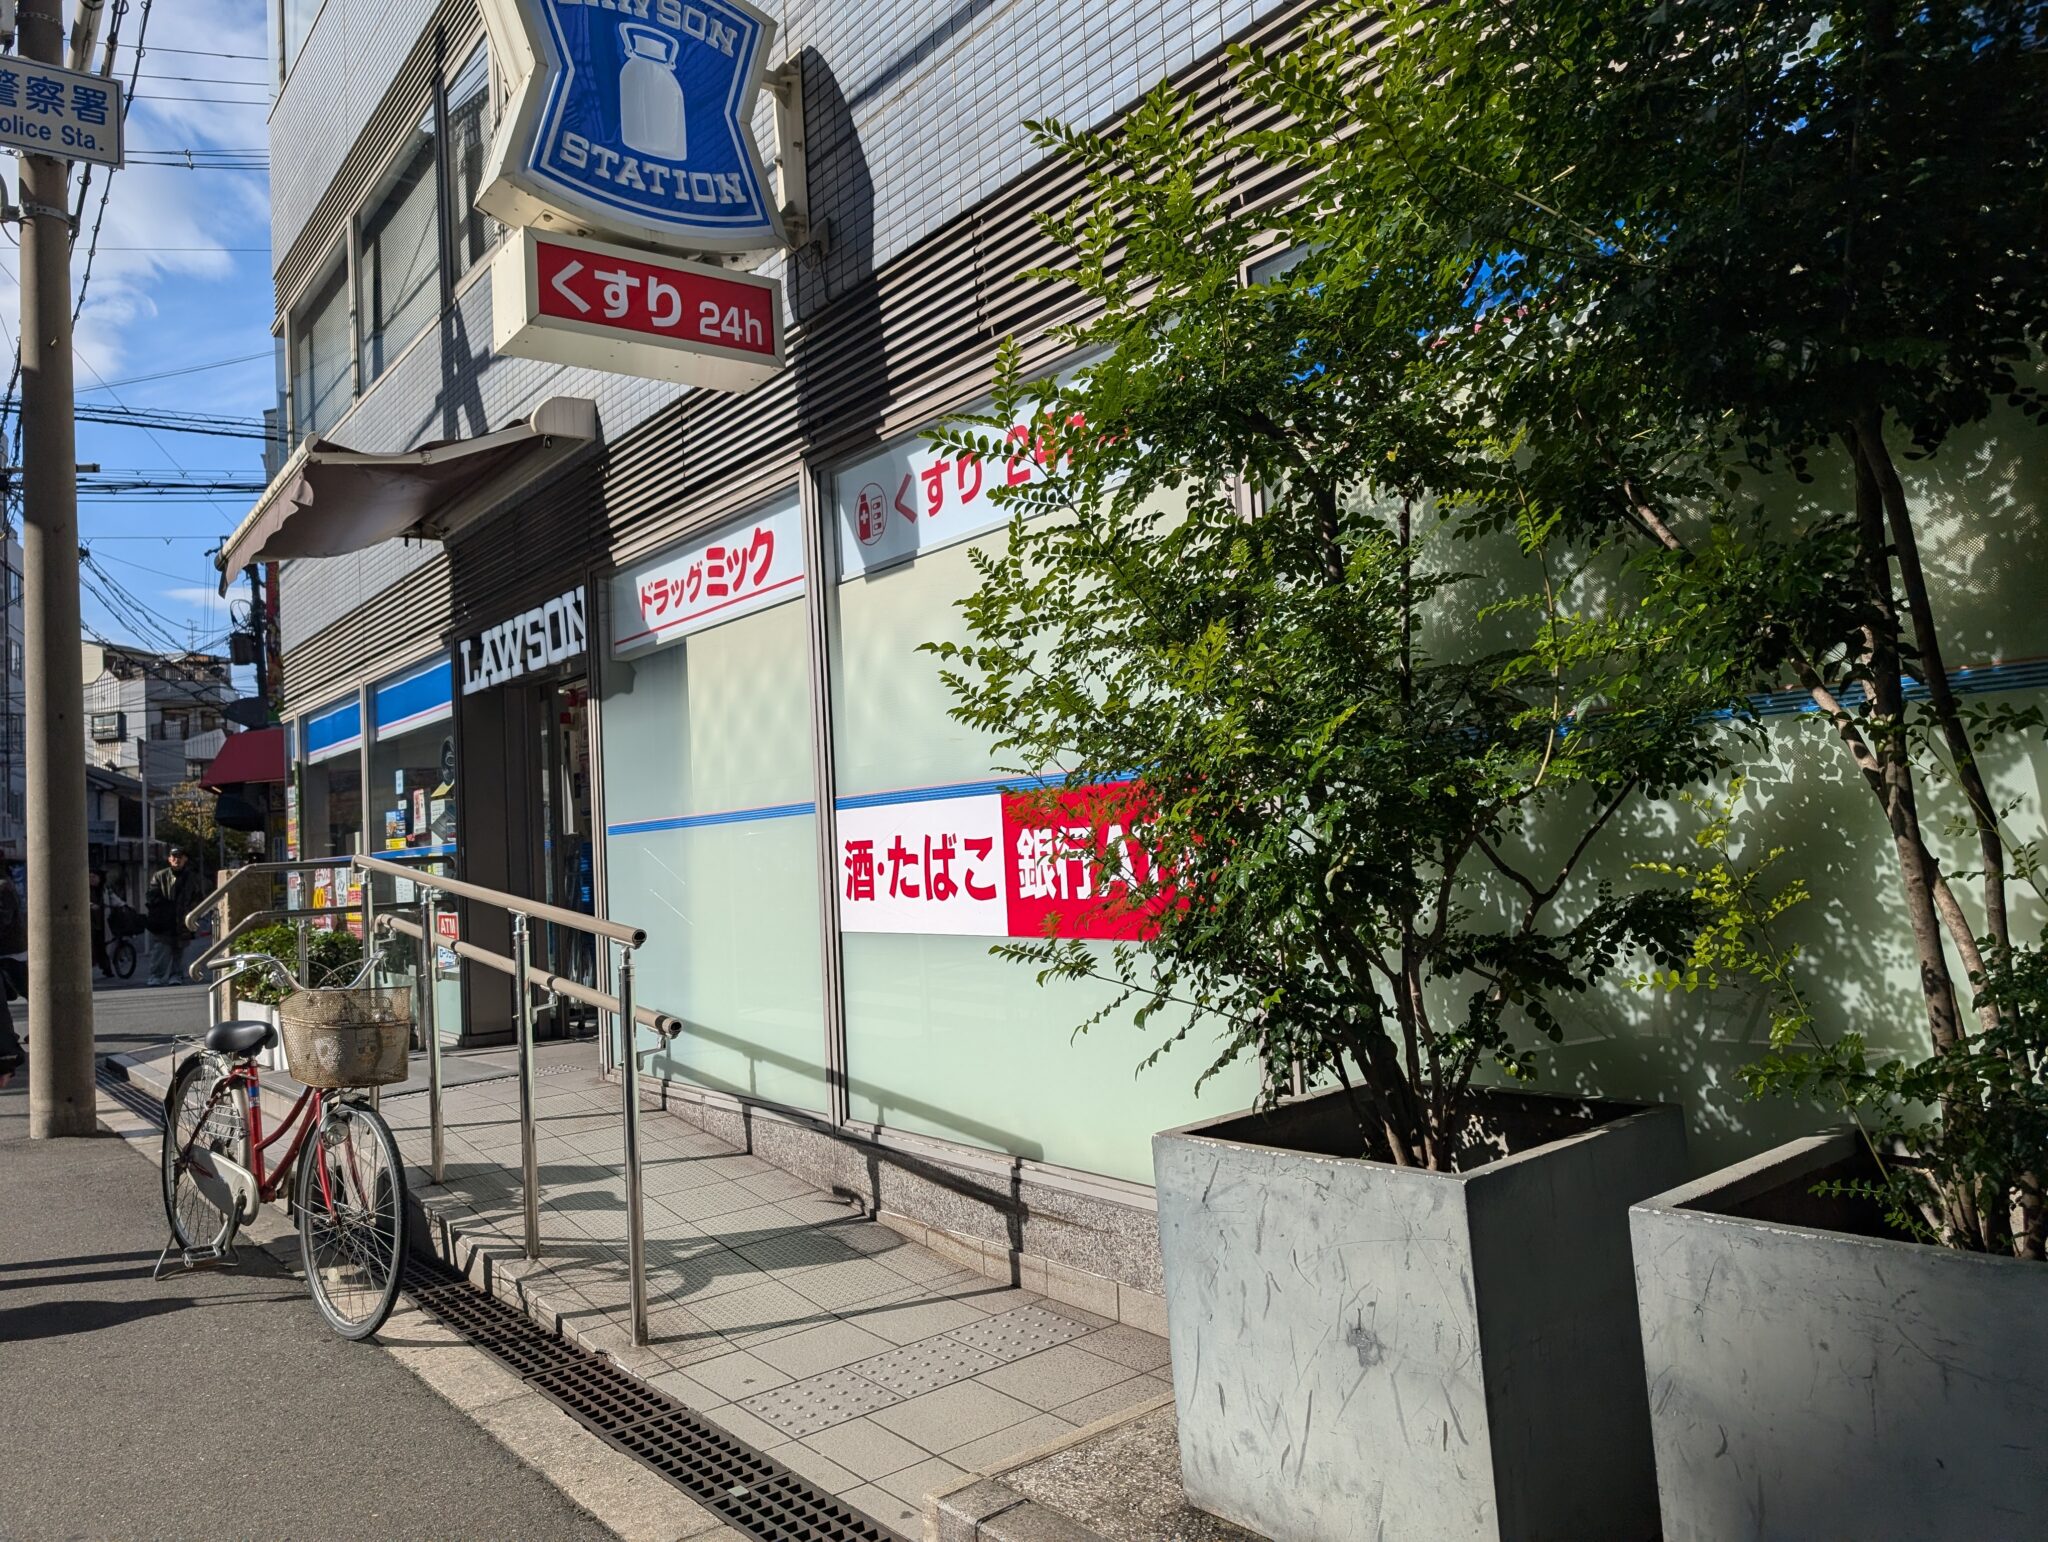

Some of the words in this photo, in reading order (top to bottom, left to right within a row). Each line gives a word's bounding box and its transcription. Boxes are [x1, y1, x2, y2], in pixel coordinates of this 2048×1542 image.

[557, 0, 738, 58] WSON
[61, 125, 104, 151] Sta.
[560, 132, 747, 204] STATION
[551, 260, 682, 327] くすり
[699, 301, 763, 345] 24h
[894, 450, 982, 524] くすり
[459, 585, 587, 696] LAWSON
[844, 832, 997, 902] 酒・たばこ
[441, 917, 456, 934] ATM
